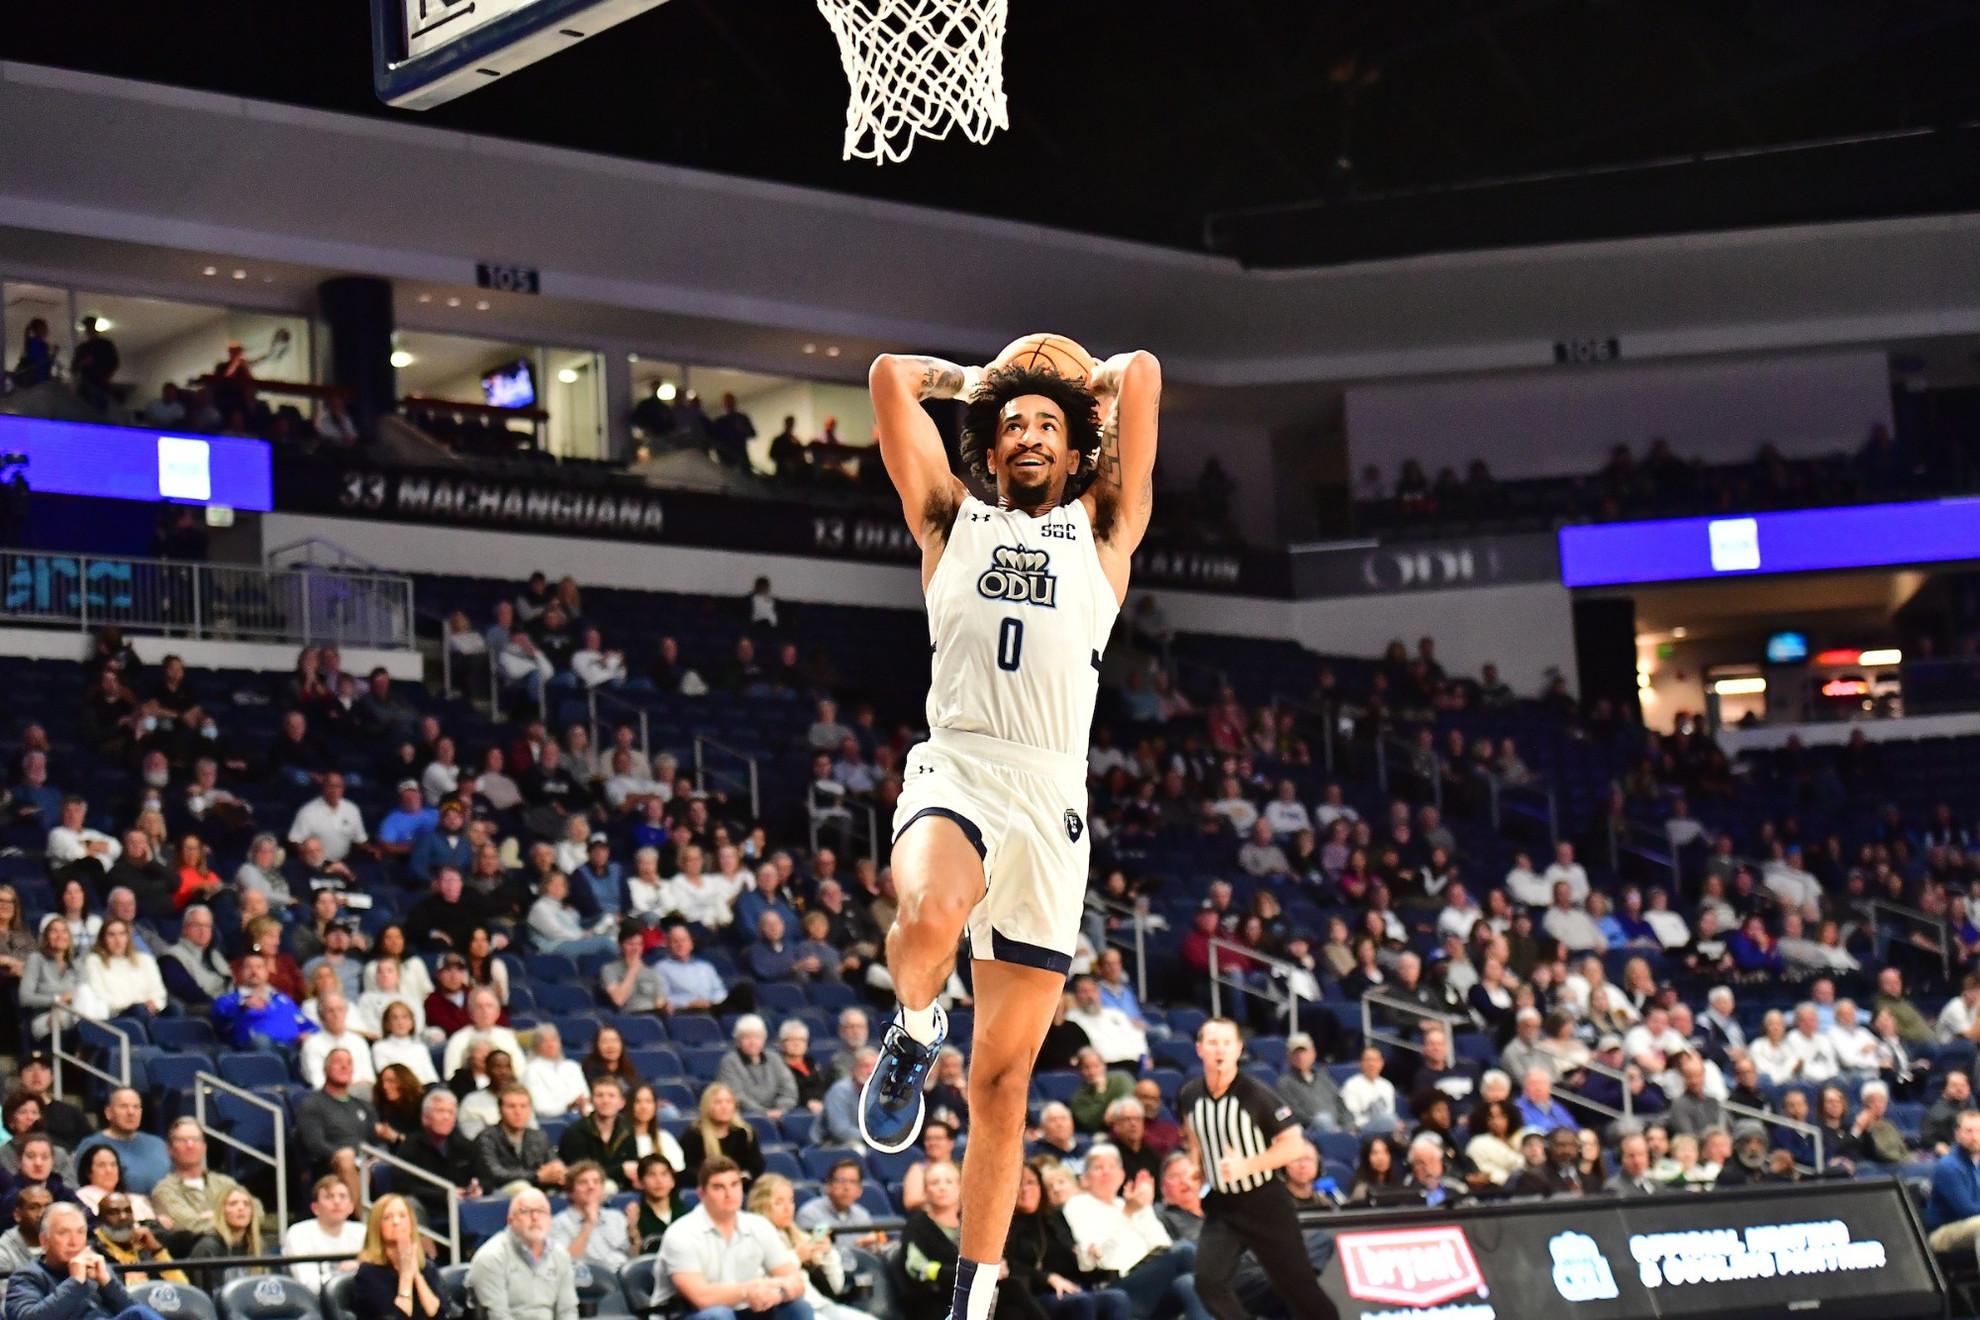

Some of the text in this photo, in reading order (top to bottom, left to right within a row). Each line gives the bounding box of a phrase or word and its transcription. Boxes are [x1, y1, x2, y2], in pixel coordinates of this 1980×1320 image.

[487, 264, 532, 294] 105
[340, 472, 387, 509] 33
[1041, 524, 1076, 541] SBC
[978, 570, 1056, 608] ODU
[997, 616, 1023, 672] 0
